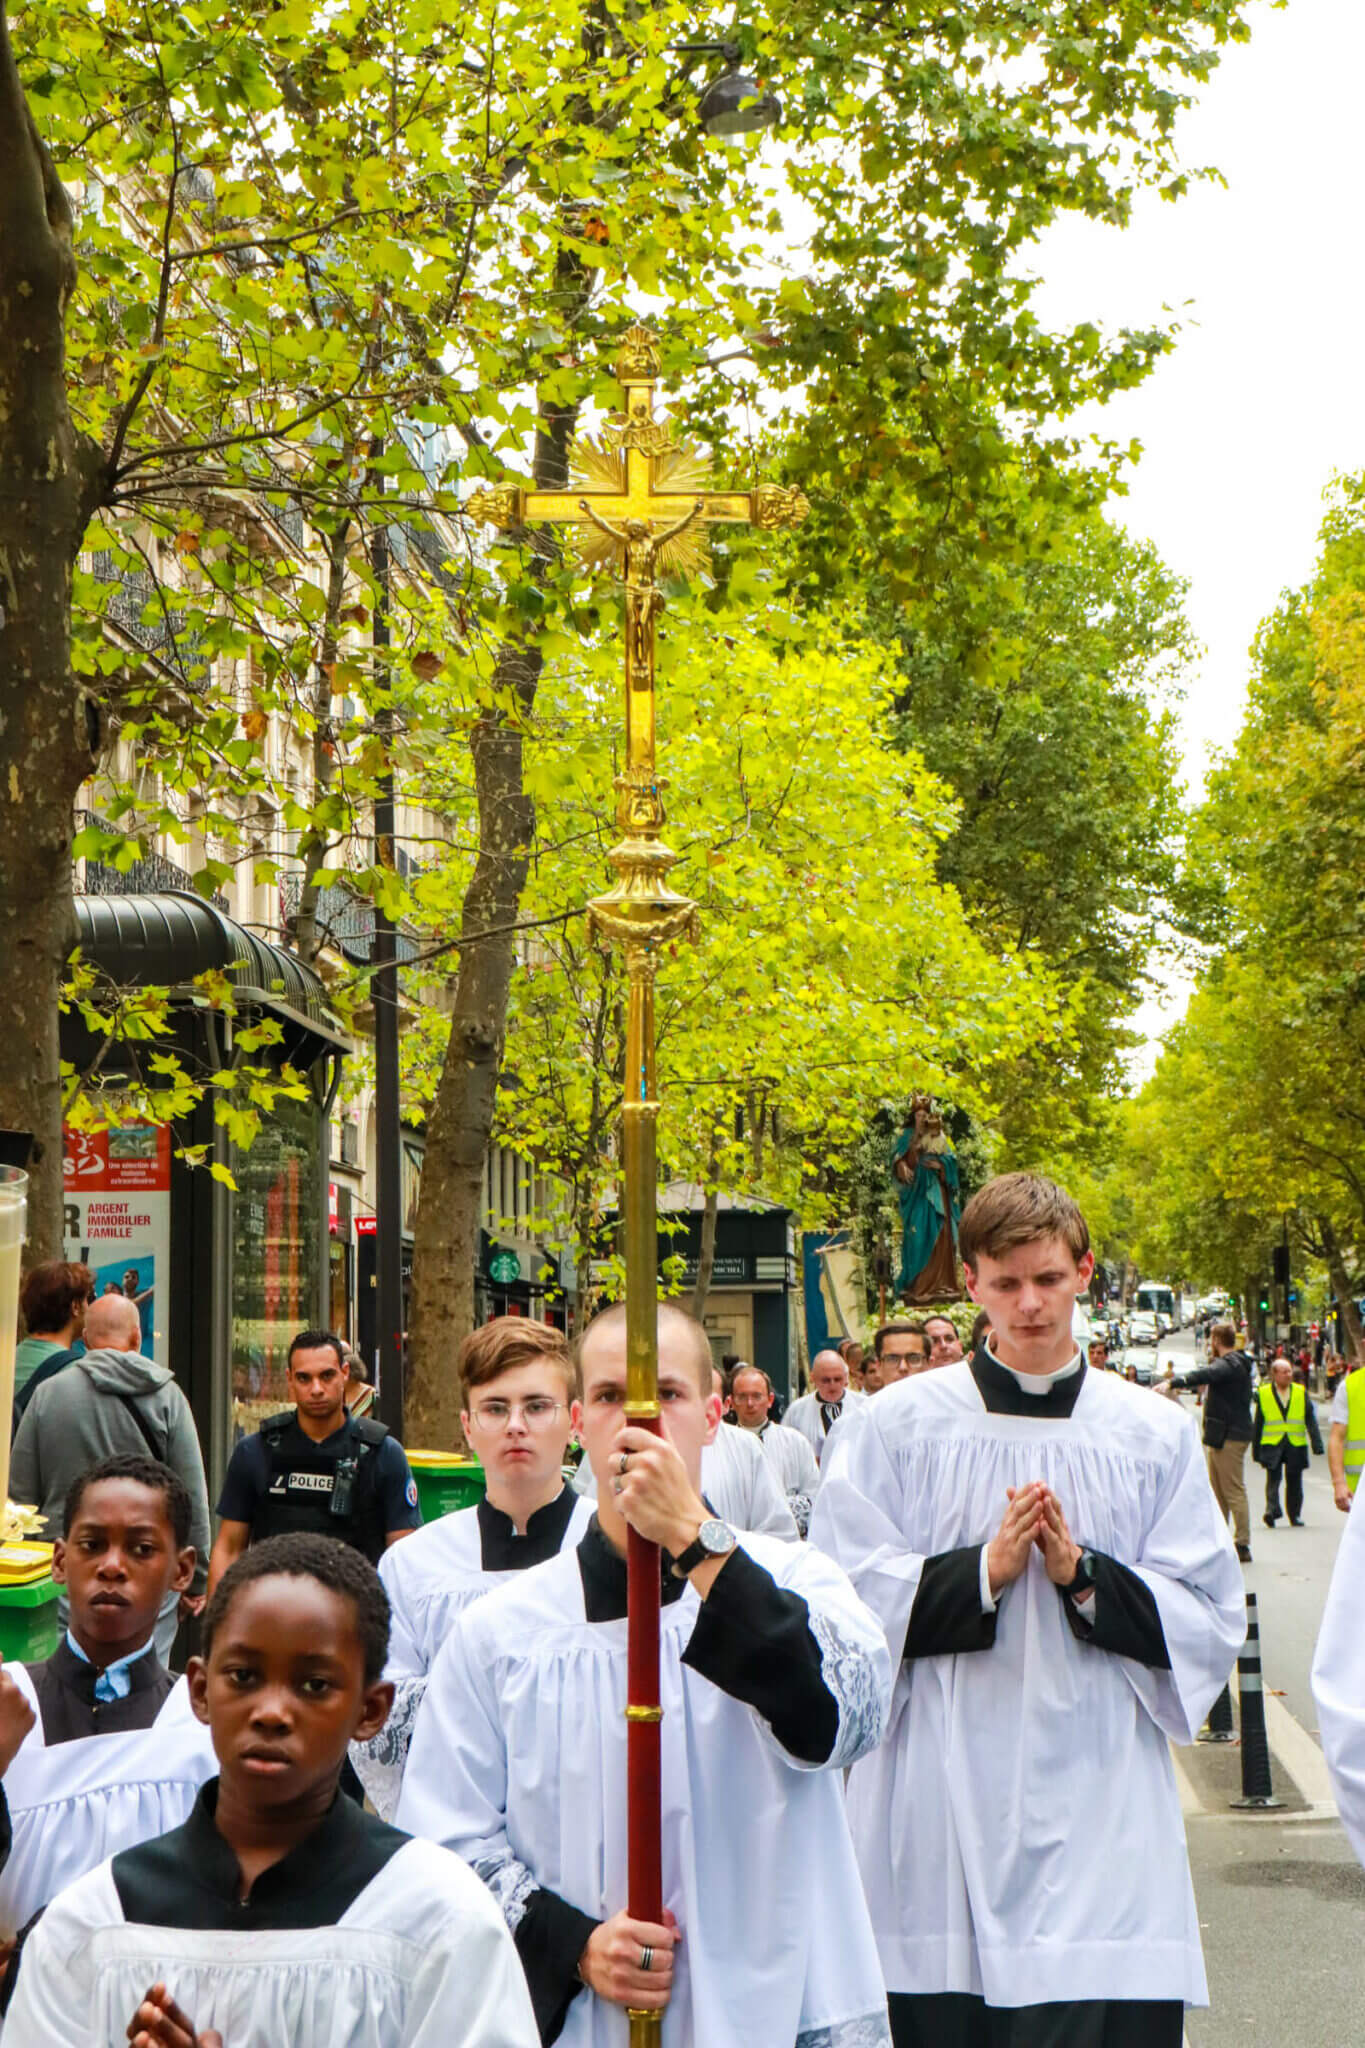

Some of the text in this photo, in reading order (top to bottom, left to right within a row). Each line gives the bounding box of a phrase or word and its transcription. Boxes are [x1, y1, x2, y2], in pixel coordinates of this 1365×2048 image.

[88, 1203, 129, 1214] ARGENT
[88, 1215, 151, 1226] IMMOBILIER
[88, 1227, 132, 1238] FAMILLE
[290, 1475, 334, 1489] POLICE
